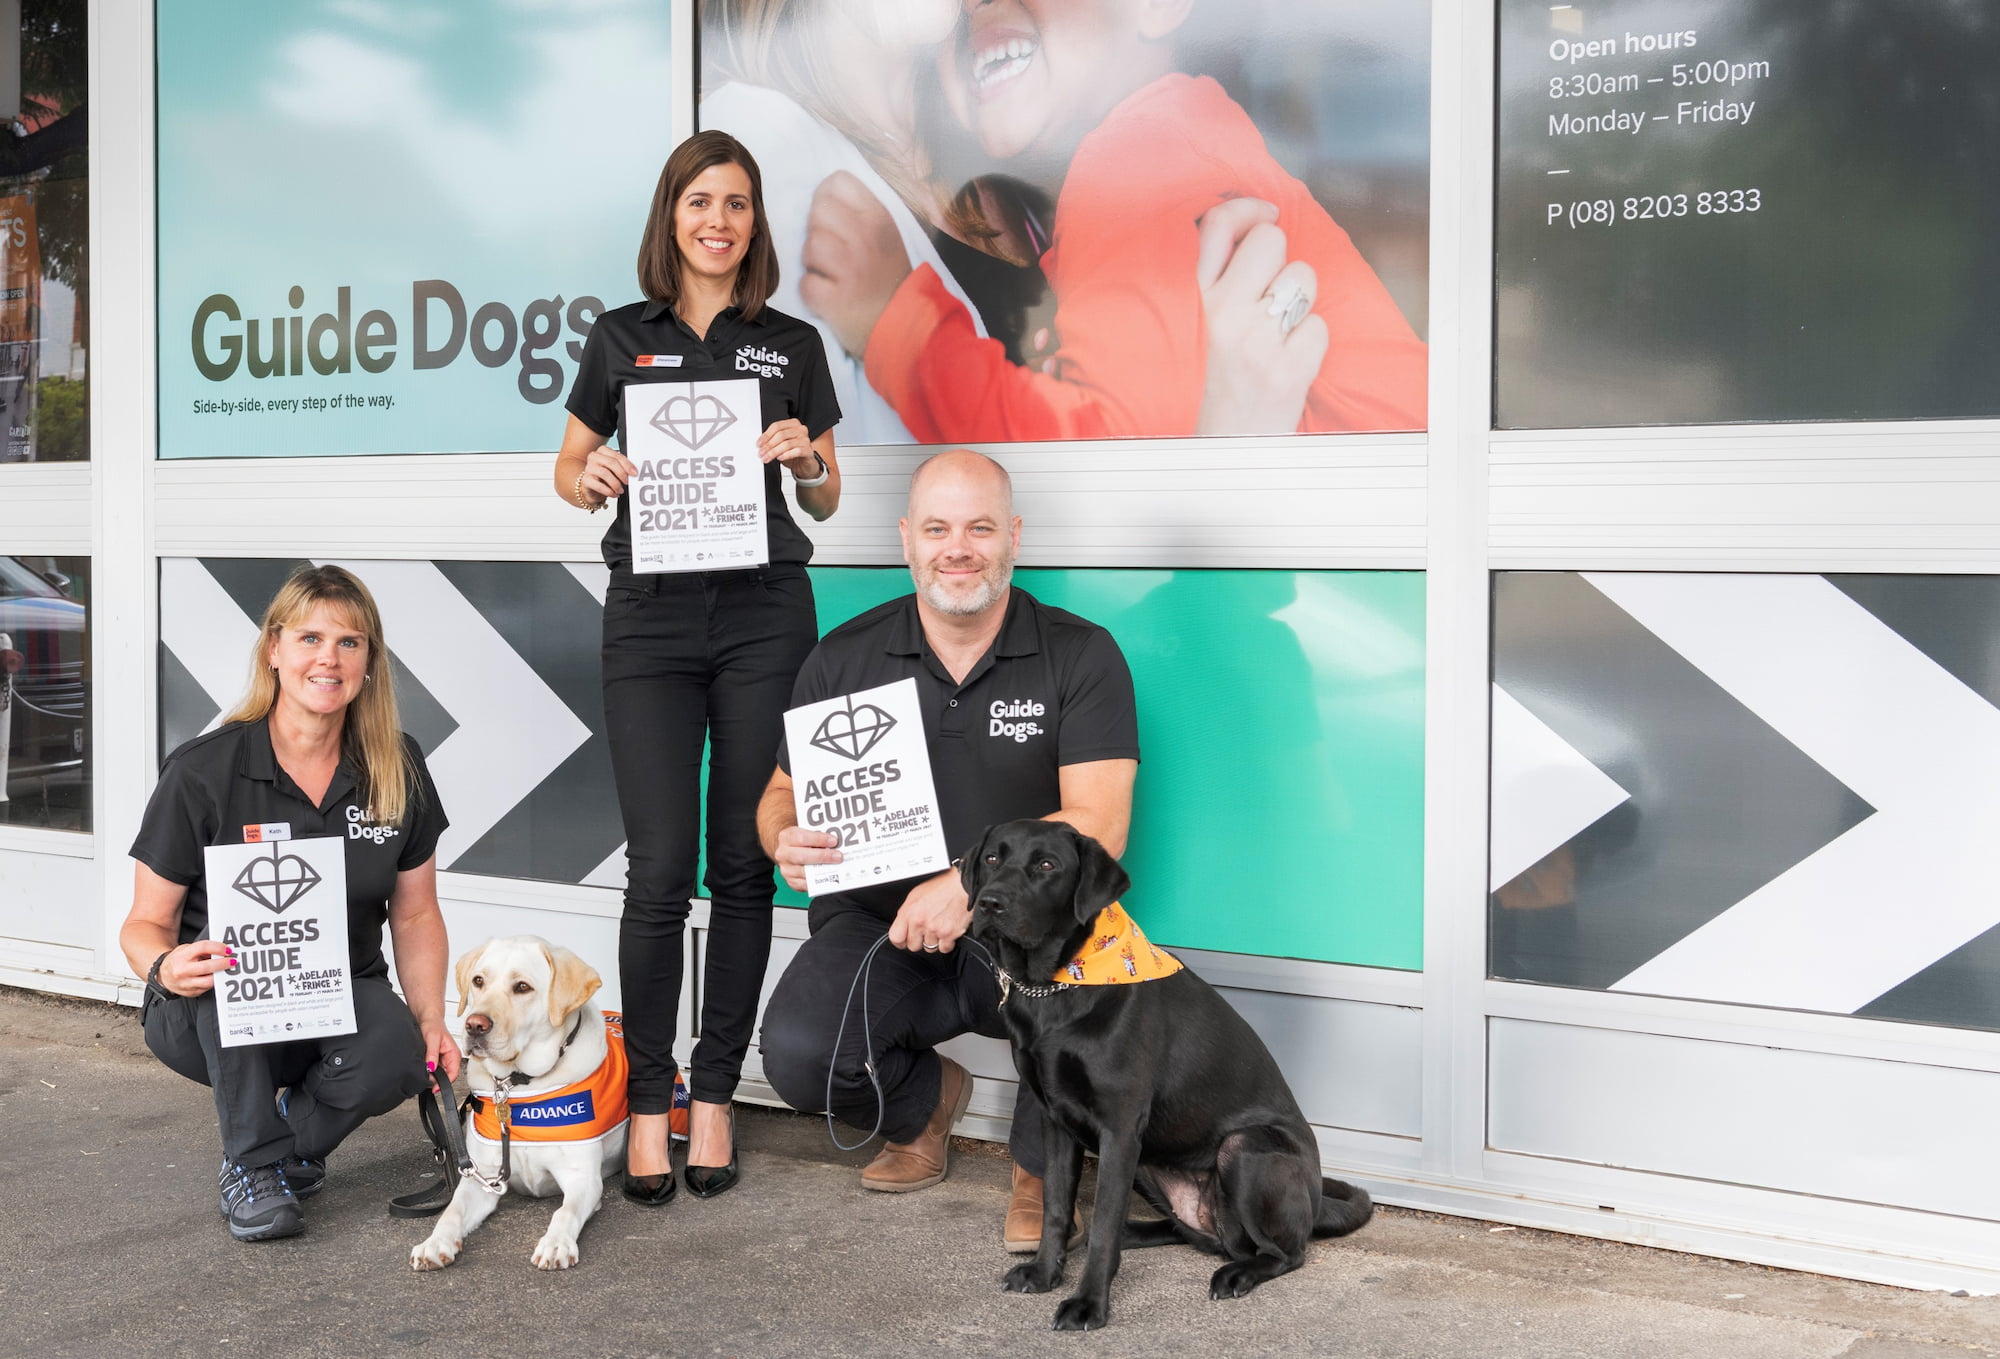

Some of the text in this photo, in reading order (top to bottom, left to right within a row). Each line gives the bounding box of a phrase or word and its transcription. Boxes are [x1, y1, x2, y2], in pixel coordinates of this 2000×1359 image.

[1549, 29, 1697, 65] Open hours
[1549, 73, 1639, 99] 8:30am
[1672, 60, 1769, 87] 5:00pm
[1548, 109, 1645, 136] Monday
[1678, 99, 1755, 125] Friday
[1548, 188, 1762, 229] P (08) 8203 8333
[191, 279, 606, 405] Guide Dogs
[736, 345, 789, 366] Guide
[193, 393, 395, 416] Side-by-side, every step of the way.
[638, 456, 735, 482] ACCESS
[639, 482, 717, 506] GUIDE
[640, 507, 698, 532] 2021
[714, 503, 758, 515] ADELAIDE
[716, 513, 745, 523] FRINGE
[989, 699, 1045, 719] Guide
[989, 718, 1045, 743] Dogs.
[804, 759, 901, 803] ACCESS
[807, 789, 886, 826] GUIDE
[884, 805, 930, 822] ADELAIDE
[348, 823, 399, 845] Dogs.
[818, 819, 871, 849] 021
[888, 818, 919, 832] FRINGE
[222, 919, 319, 948] ACCESS
[225, 947, 302, 976] GUIDE
[298, 968, 342, 981] ADELAIDE
[302, 979, 331, 991] FRINGE
[225, 975, 285, 1003] 2021
[519, 1101, 586, 1120] ADVANCE
